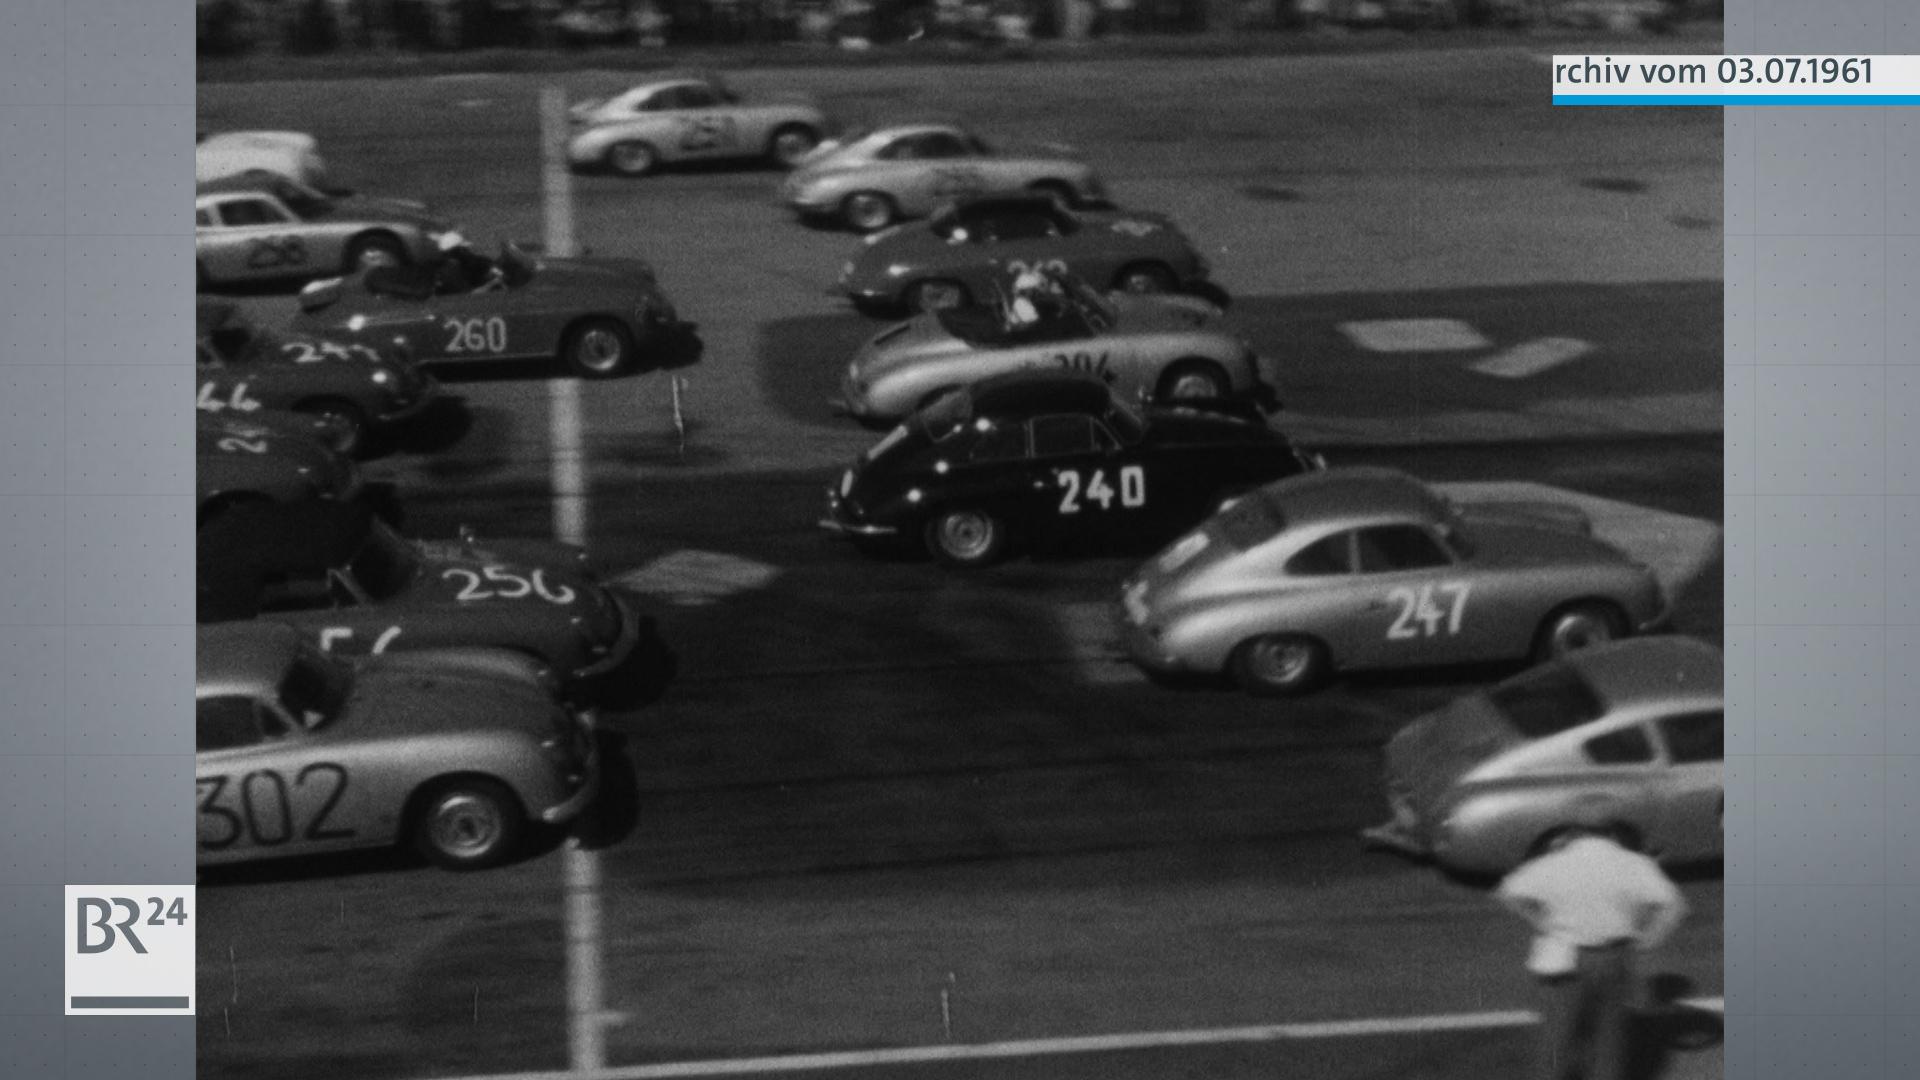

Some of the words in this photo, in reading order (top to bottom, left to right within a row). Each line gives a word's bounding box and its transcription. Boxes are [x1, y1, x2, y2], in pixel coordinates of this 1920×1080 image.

[444, 316, 507, 352] 260
[1058, 466, 1145, 514] 240
[442, 566, 575, 604] 256
[1386, 580, 1472, 640] 247
[196, 762, 355, 848] 302
